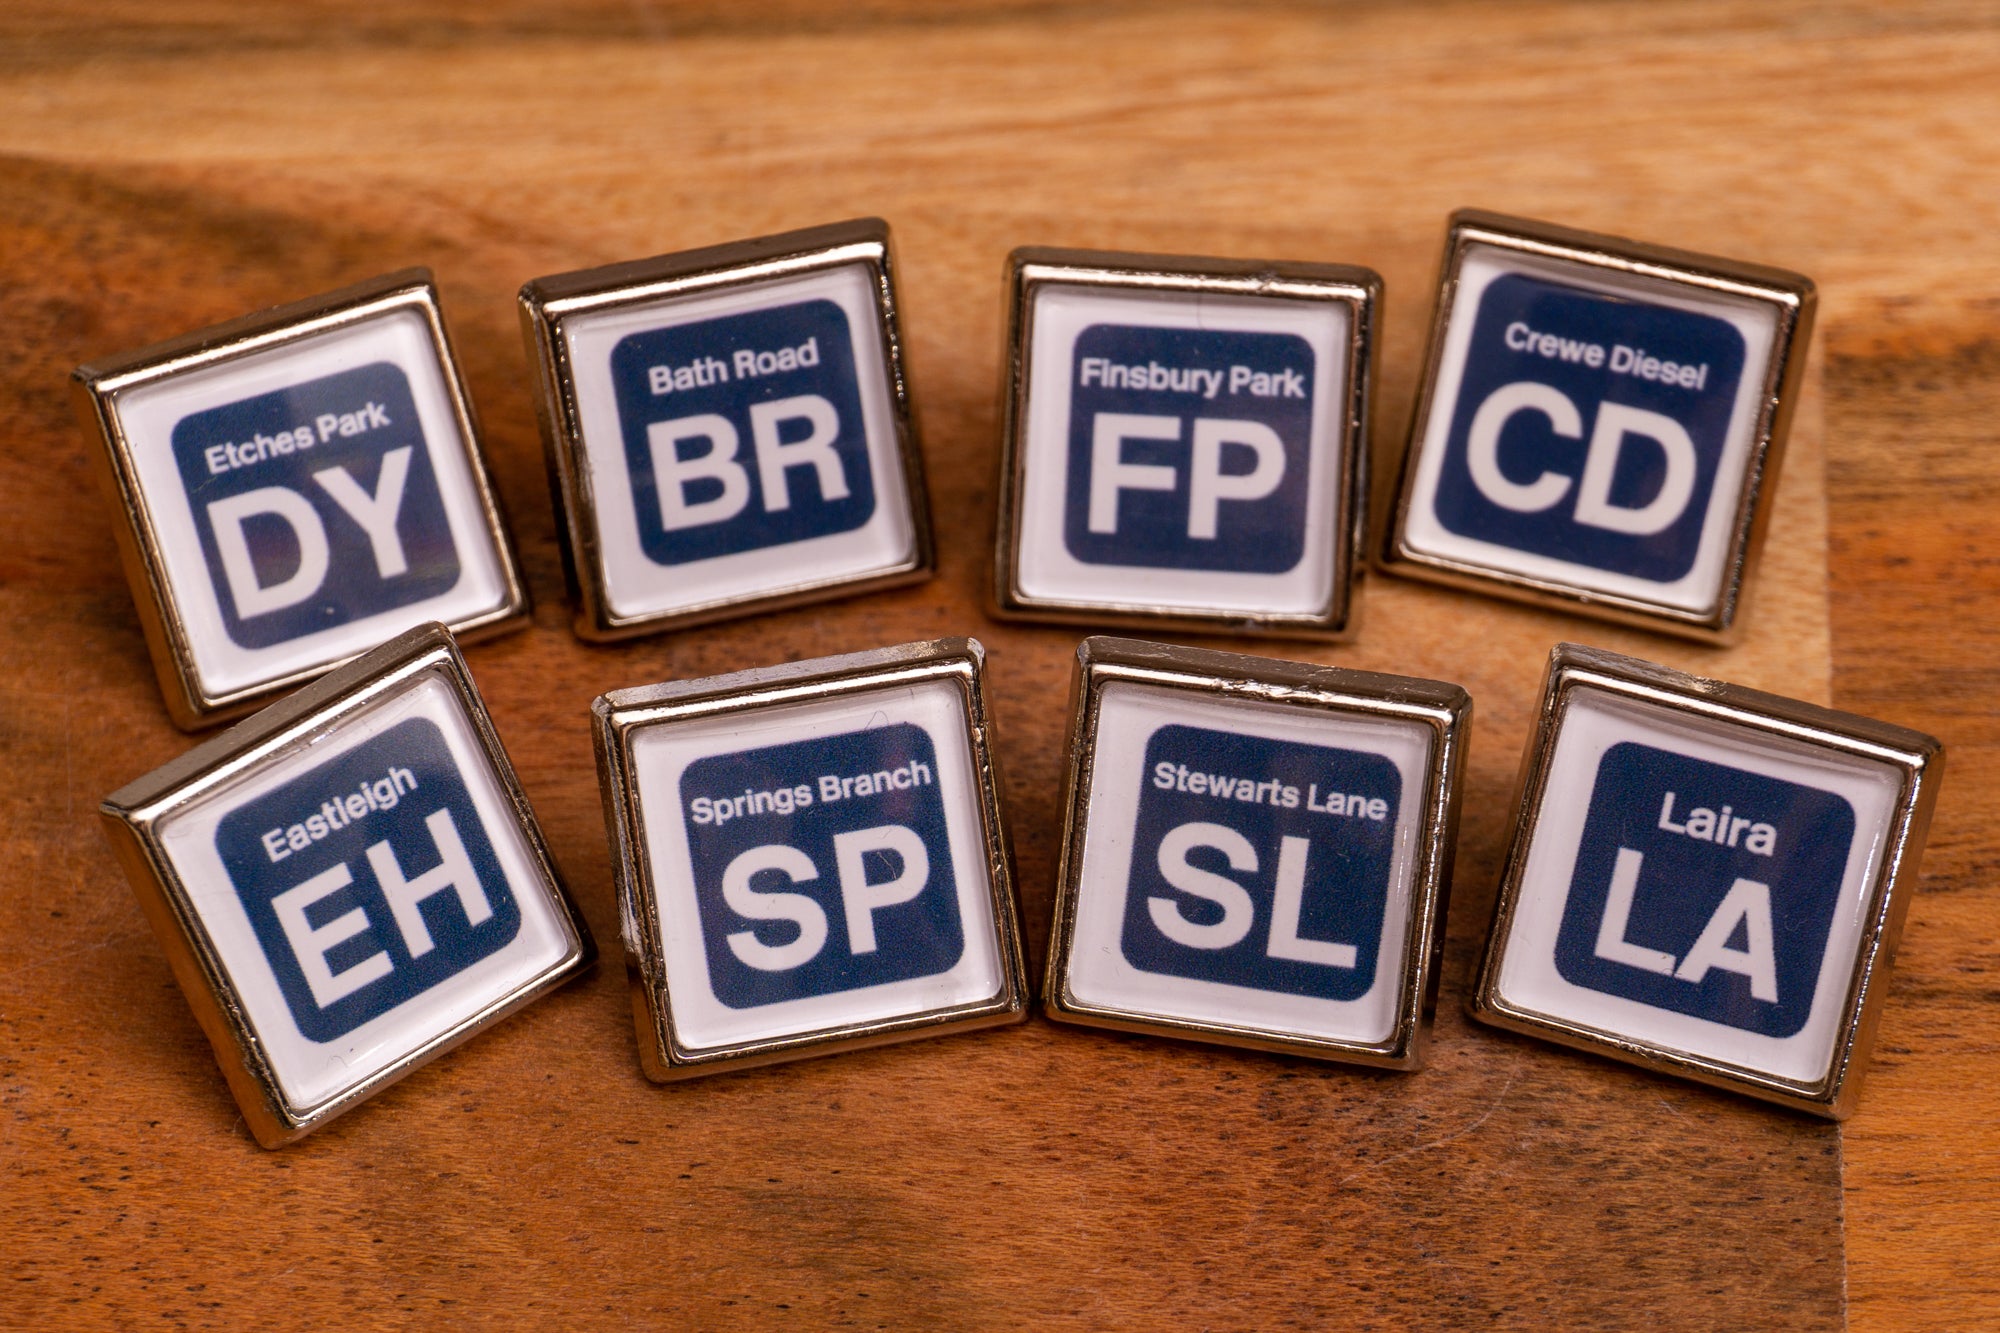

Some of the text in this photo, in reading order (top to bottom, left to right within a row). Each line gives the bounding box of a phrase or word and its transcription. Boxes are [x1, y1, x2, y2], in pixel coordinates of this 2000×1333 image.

[648, 337, 820, 395] Bath Road
[1080, 357, 1305, 399] Finsbury Park
[1505, 322, 1707, 389] Crewe Diesel
[204, 401, 392, 475] Etches Park
[647, 394, 849, 531] BR
[1088, 412, 1287, 539] FP
[1467, 382, 1697, 535] CD
[206, 445, 413, 621] DY
[260, 766, 418, 863] Eastleigh
[690, 759, 932, 826] Springs Branch
[1153, 761, 1388, 821] Stewarts Lane
[1658, 791, 1777, 857] Laira
[270, 807, 494, 1009] EH
[721, 824, 930, 973] SP
[1147, 821, 1357, 969] SL
[1594, 847, 1779, 1003] LA
